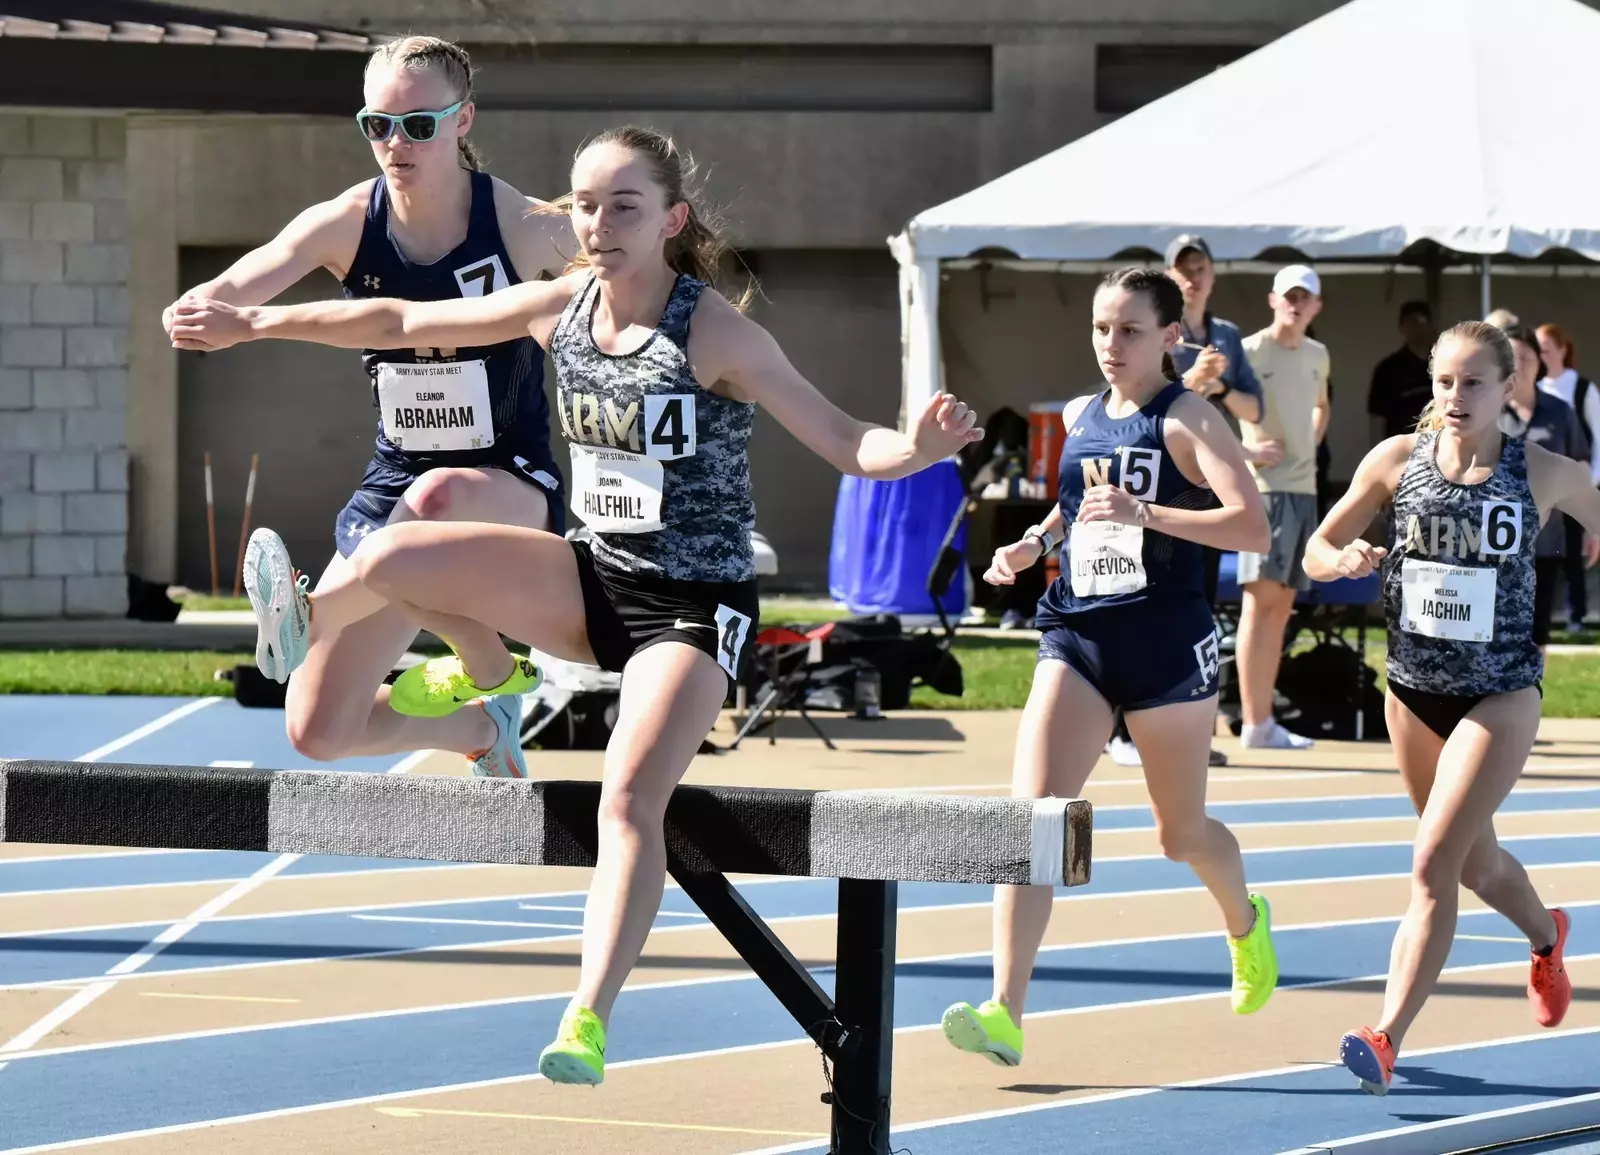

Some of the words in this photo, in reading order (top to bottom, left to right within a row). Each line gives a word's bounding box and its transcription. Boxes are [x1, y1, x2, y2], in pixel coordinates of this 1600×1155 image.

[461, 262, 496, 297] 7
[396, 367, 428, 376] ARMY/NAVY
[430, 368, 444, 376] STAR
[446, 366, 462, 374] MEET
[416, 392, 445, 401] ELEANOR
[395, 406, 475, 428] ABRAHAM
[651, 398, 690, 456] 4
[598, 477, 622, 488] JOANNA
[1124, 451, 1153, 497] 5
[584, 491, 645, 519] HALFHILL
[1405, 514, 1508, 563] ARM
[1487, 505, 1517, 551] 6
[1077, 556, 1137, 577] LUTKEVICH
[1434, 588, 1458, 597] MELISSA
[1421, 599, 1471, 622] JACHIM
[721, 615, 742, 671] 4
[1200, 637, 1218, 680] 5
